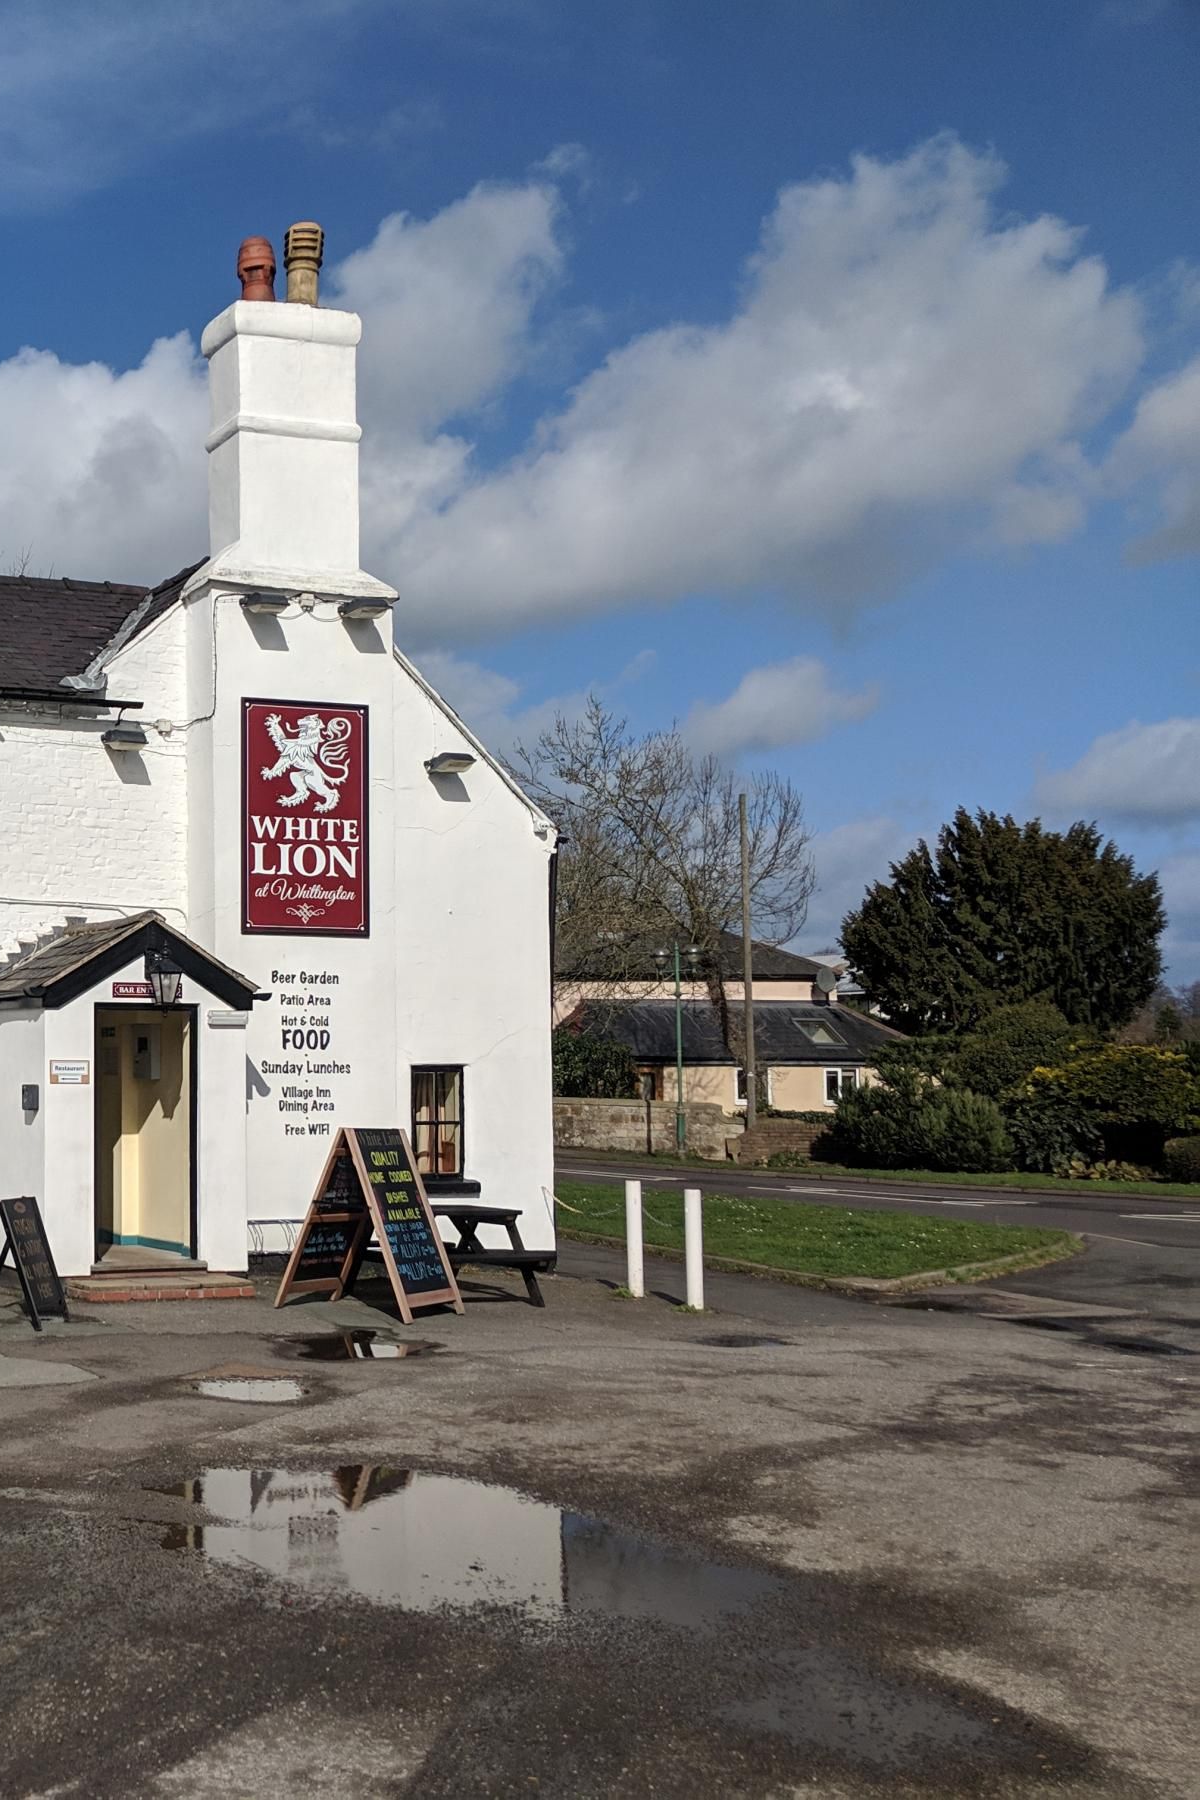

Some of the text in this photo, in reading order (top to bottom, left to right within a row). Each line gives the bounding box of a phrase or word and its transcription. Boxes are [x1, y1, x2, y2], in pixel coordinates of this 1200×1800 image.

[251, 815, 359, 843] WHITE
[251, 842, 359, 878] LION
[255, 878, 356, 906] at Whittington
[272, 970, 339, 985] Beer Garden
[119, 986, 135, 994] BAR
[280, 993, 331, 1006] Patio Area
[281, 1015, 329, 1026] Hot & Cold
[282, 1029, 330, 1050] FOOD
[261, 1060, 351, 1076] Sunday Lunches
[282, 1086, 331, 1100] Village Inn
[279, 1100, 335, 1114] Dining Area
[285, 1124, 305, 1135] Free
[370, 1151, 400, 1166] QUALITY
[388, 1171, 412, 1182] COOKED
[386, 1191, 409, 1204] DISHES
[387, 1208, 422, 1221] AVAILABLE
